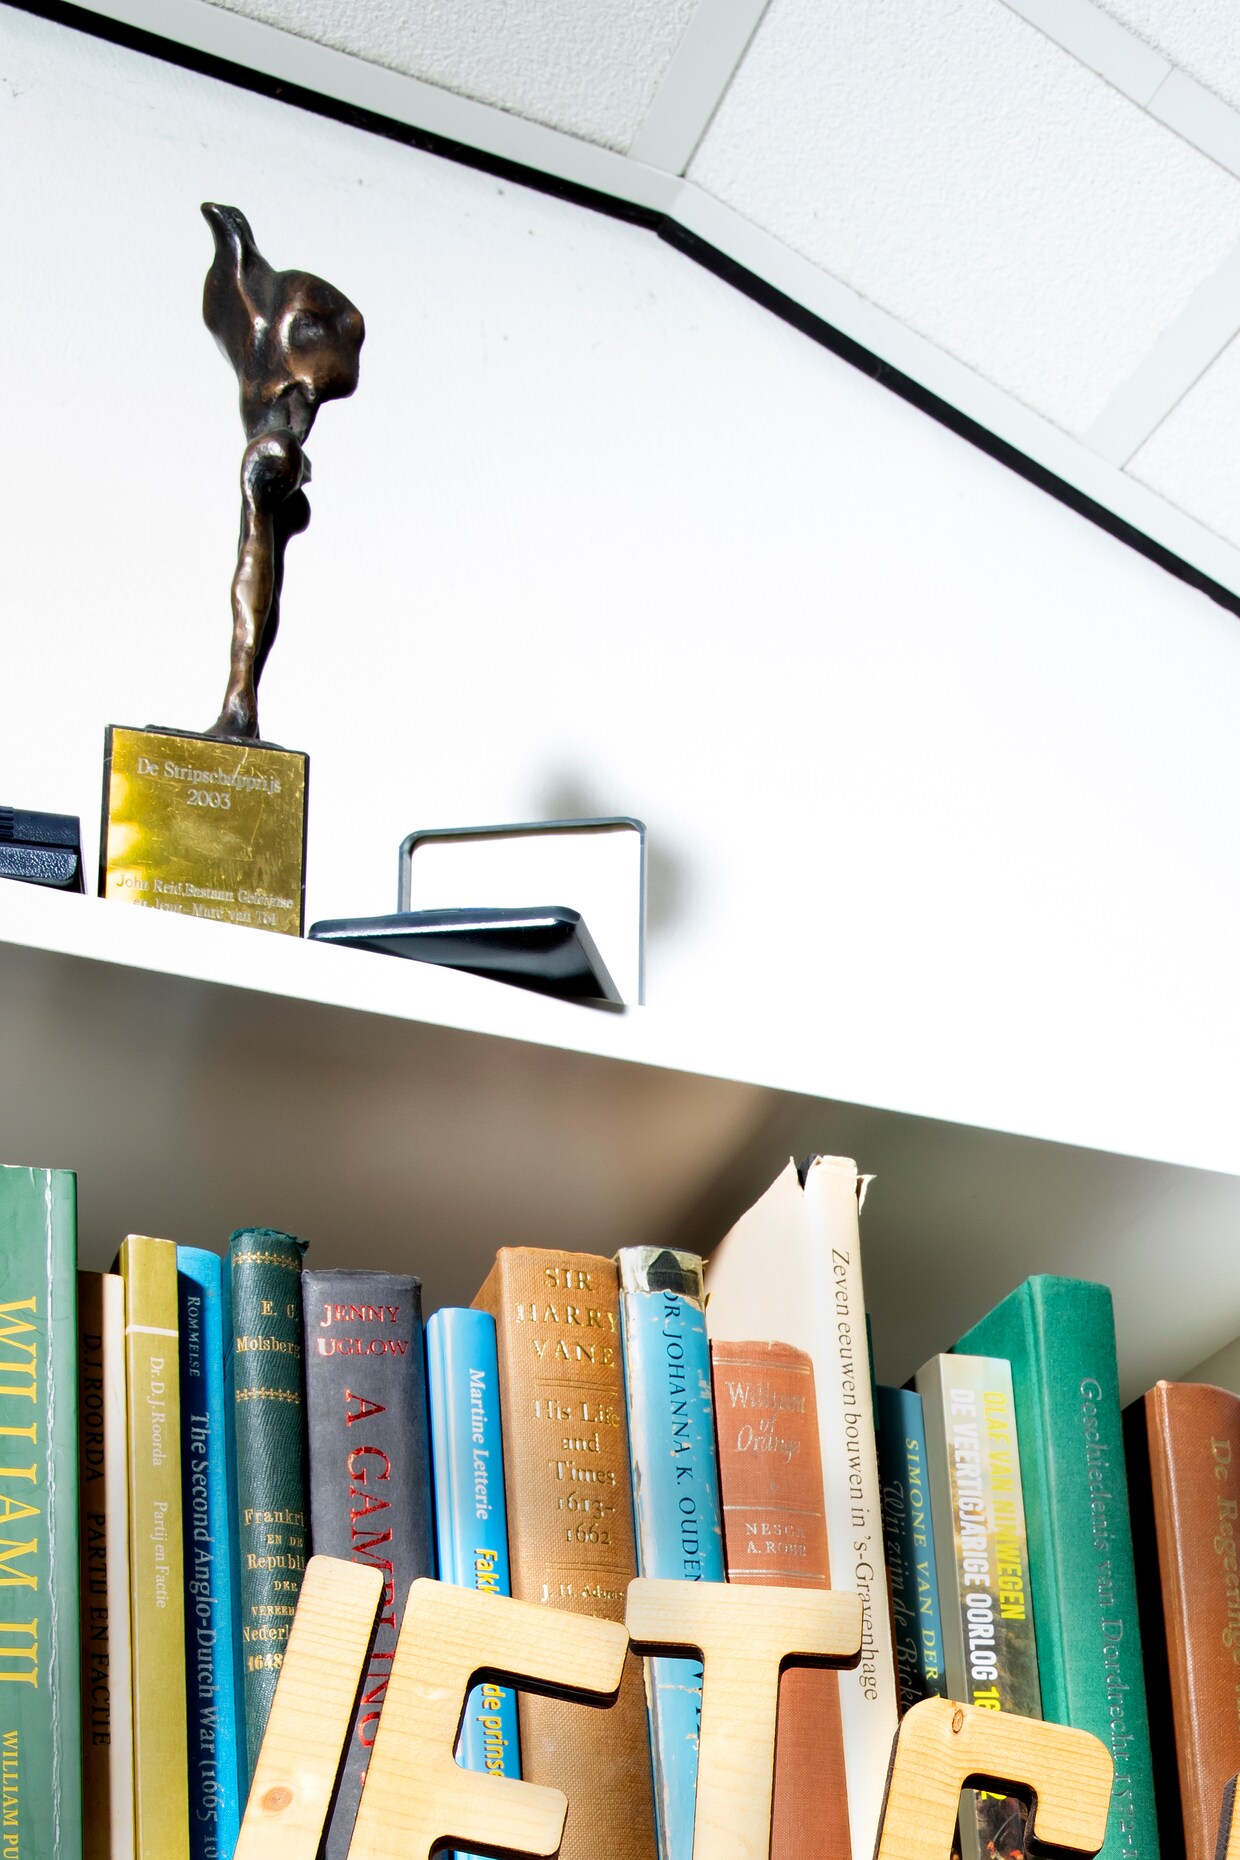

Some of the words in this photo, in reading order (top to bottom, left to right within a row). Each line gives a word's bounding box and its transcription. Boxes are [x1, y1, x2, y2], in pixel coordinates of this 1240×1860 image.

[137, 757, 160, 776] De
[164, 760, 282, 795] Stripschapprijs
[186, 788, 232, 810] 2003
[116, 874, 149, 892] John
[545, 1267, 596, 1293] SIR
[830, 1248, 853, 1317] Zeven
[261, 1300, 277, 1316] E.
[320, 1304, 400, 1328] JENNY
[514, 1302, 619, 1334] HARRY
[317, 1337, 409, 1357] UGLOW
[532, 1339, 616, 1368] VANE
[836, 1321, 860, 1407] eeuwen
[345, 1389, 388, 1428] A
[467, 1367, 488, 1444] Martine
[531, 1399, 572, 1421] His
[579, 1401, 621, 1429] Life
[662, 1330, 693, 1454] JOHANNA
[948, 1387, 974, 1419] DE
[189, 1412, 211, 1454] The
[759, 1412, 777, 1434] of
[983, 1390, 1006, 1446] OLAF
[0, 1295, 40, 1588] WILLIAM
[562, 1432, 601, 1454] and
[737, 1424, 801, 1465] Orange
[842, 1411, 866, 1501] bouwen
[1078, 1376, 1113, 1550] Geschiedenis
[1209, 1436, 1235, 1481] De
[472, 1448, 492, 1521] Letterie
[548, 1460, 617, 1487] Times
[675, 1465, 695, 1487] K.
[904, 1437, 928, 1547] SIMONE
[988, 1449, 1011, 1494] VAN
[150, 1501, 170, 1544] Partij
[191, 1457, 213, 1545] Second
[850, 1505, 870, 1529] in
[952, 1420, 992, 1588] VEERTIGJARIGE
[85, 1510, 108, 1596] PARTIJ
[155, 1545, 167, 1561] en
[266, 1534, 282, 1545] EN
[566, 1522, 612, 1546] 1662
[993, 1497, 1026, 1620] NIMWEGEN
[154, 1563, 170, 1609] Factie
[273, 1580, 297, 1592] DER
[915, 1560, 934, 1618] VAN
[1096, 1560, 1117, 1608] van
[88, 1604, 110, 1644] EN
[190, 1547, 219, 1703] Anglo-Dutch
[964, 1591, 998, 1681] OORLOG
[0, 1616, 40, 1690] III
[921, 1629, 940, 1682] DER
[90, 1651, 113, 1747] FACTIE
[482, 1683, 506, 1710] de
[1100, 1617, 1133, 1762] Dordrecht
[198, 1706, 219, 1753] War
[2, 1730, 20, 1827] WILLIAM
